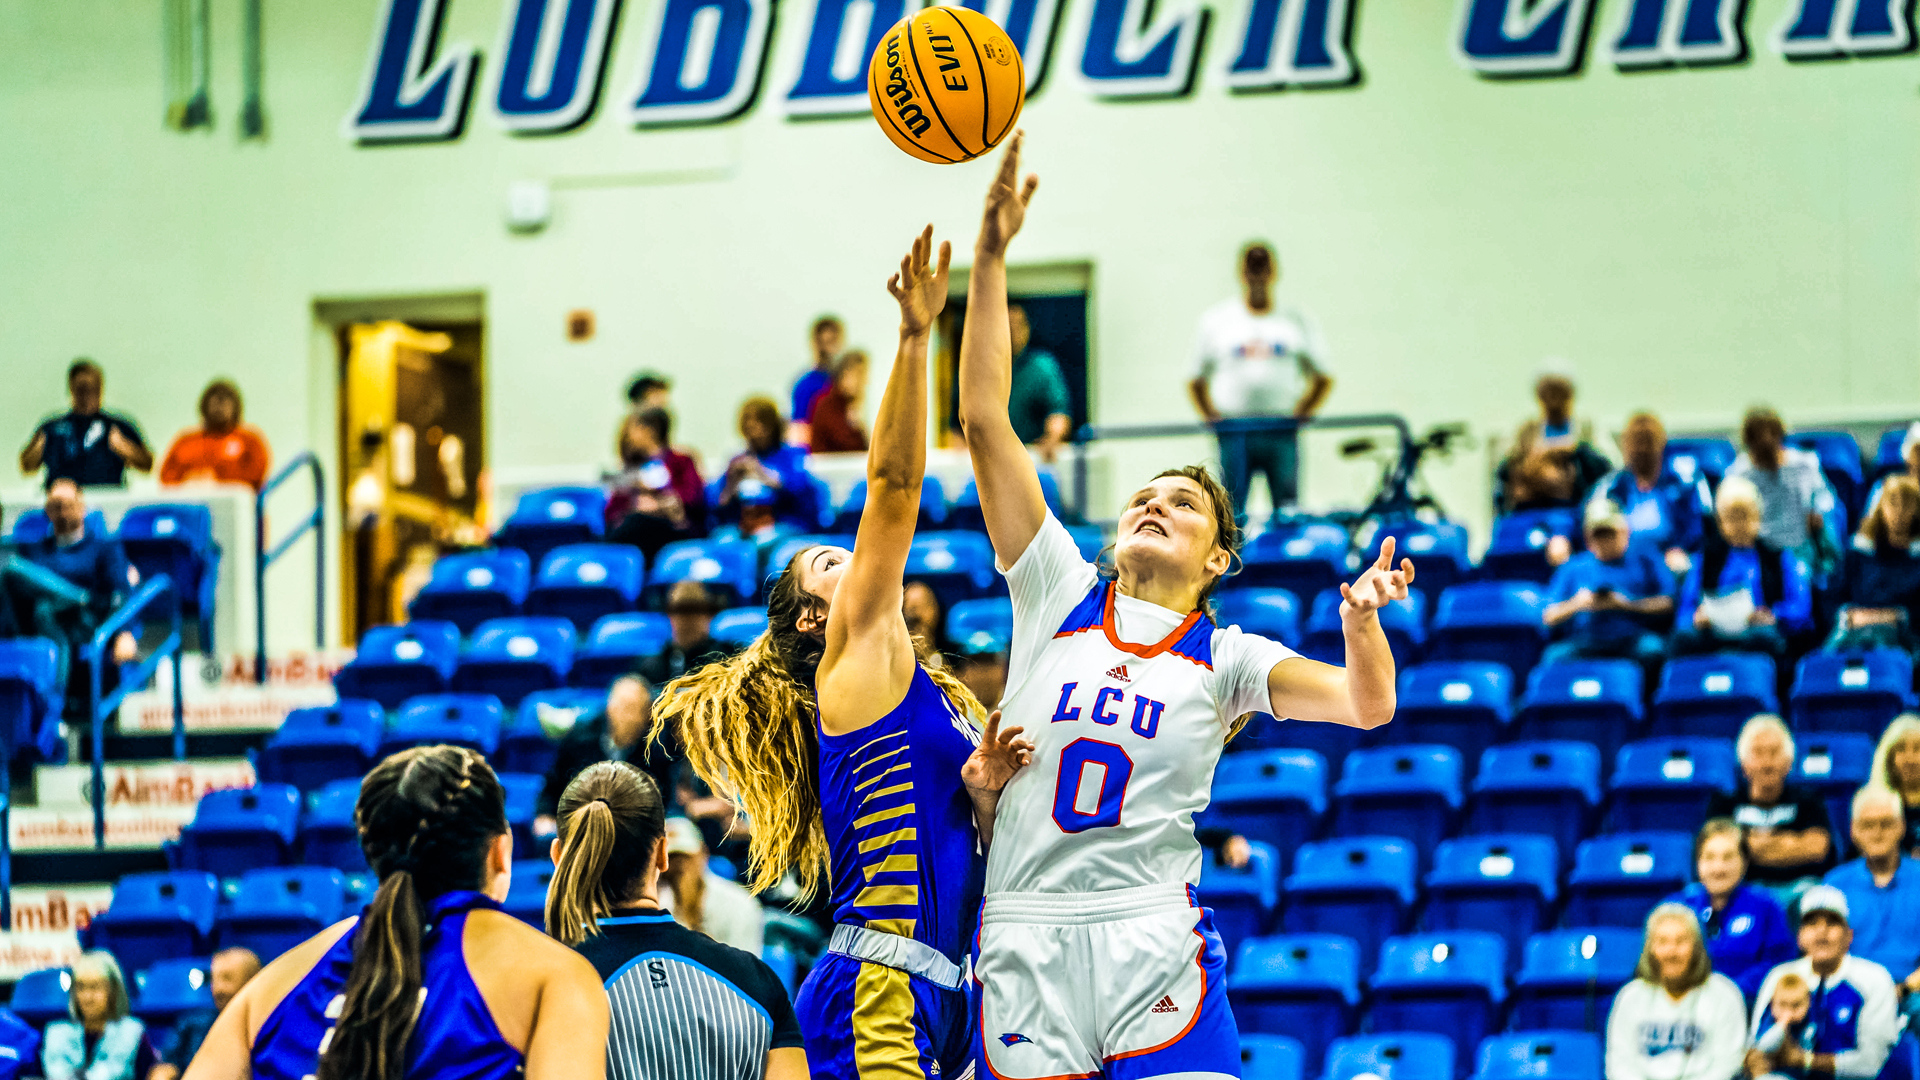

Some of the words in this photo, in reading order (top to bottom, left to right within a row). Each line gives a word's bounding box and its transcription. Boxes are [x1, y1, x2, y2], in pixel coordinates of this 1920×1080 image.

[885, 31, 932, 139] Wilson
[928, 35, 969, 92] EVO
[1105, 670, 1131, 683] adidas
[1051, 681, 1165, 740] LCU
[1051, 736, 1135, 834] 0
[1151, 1005, 1179, 1014] adidas
